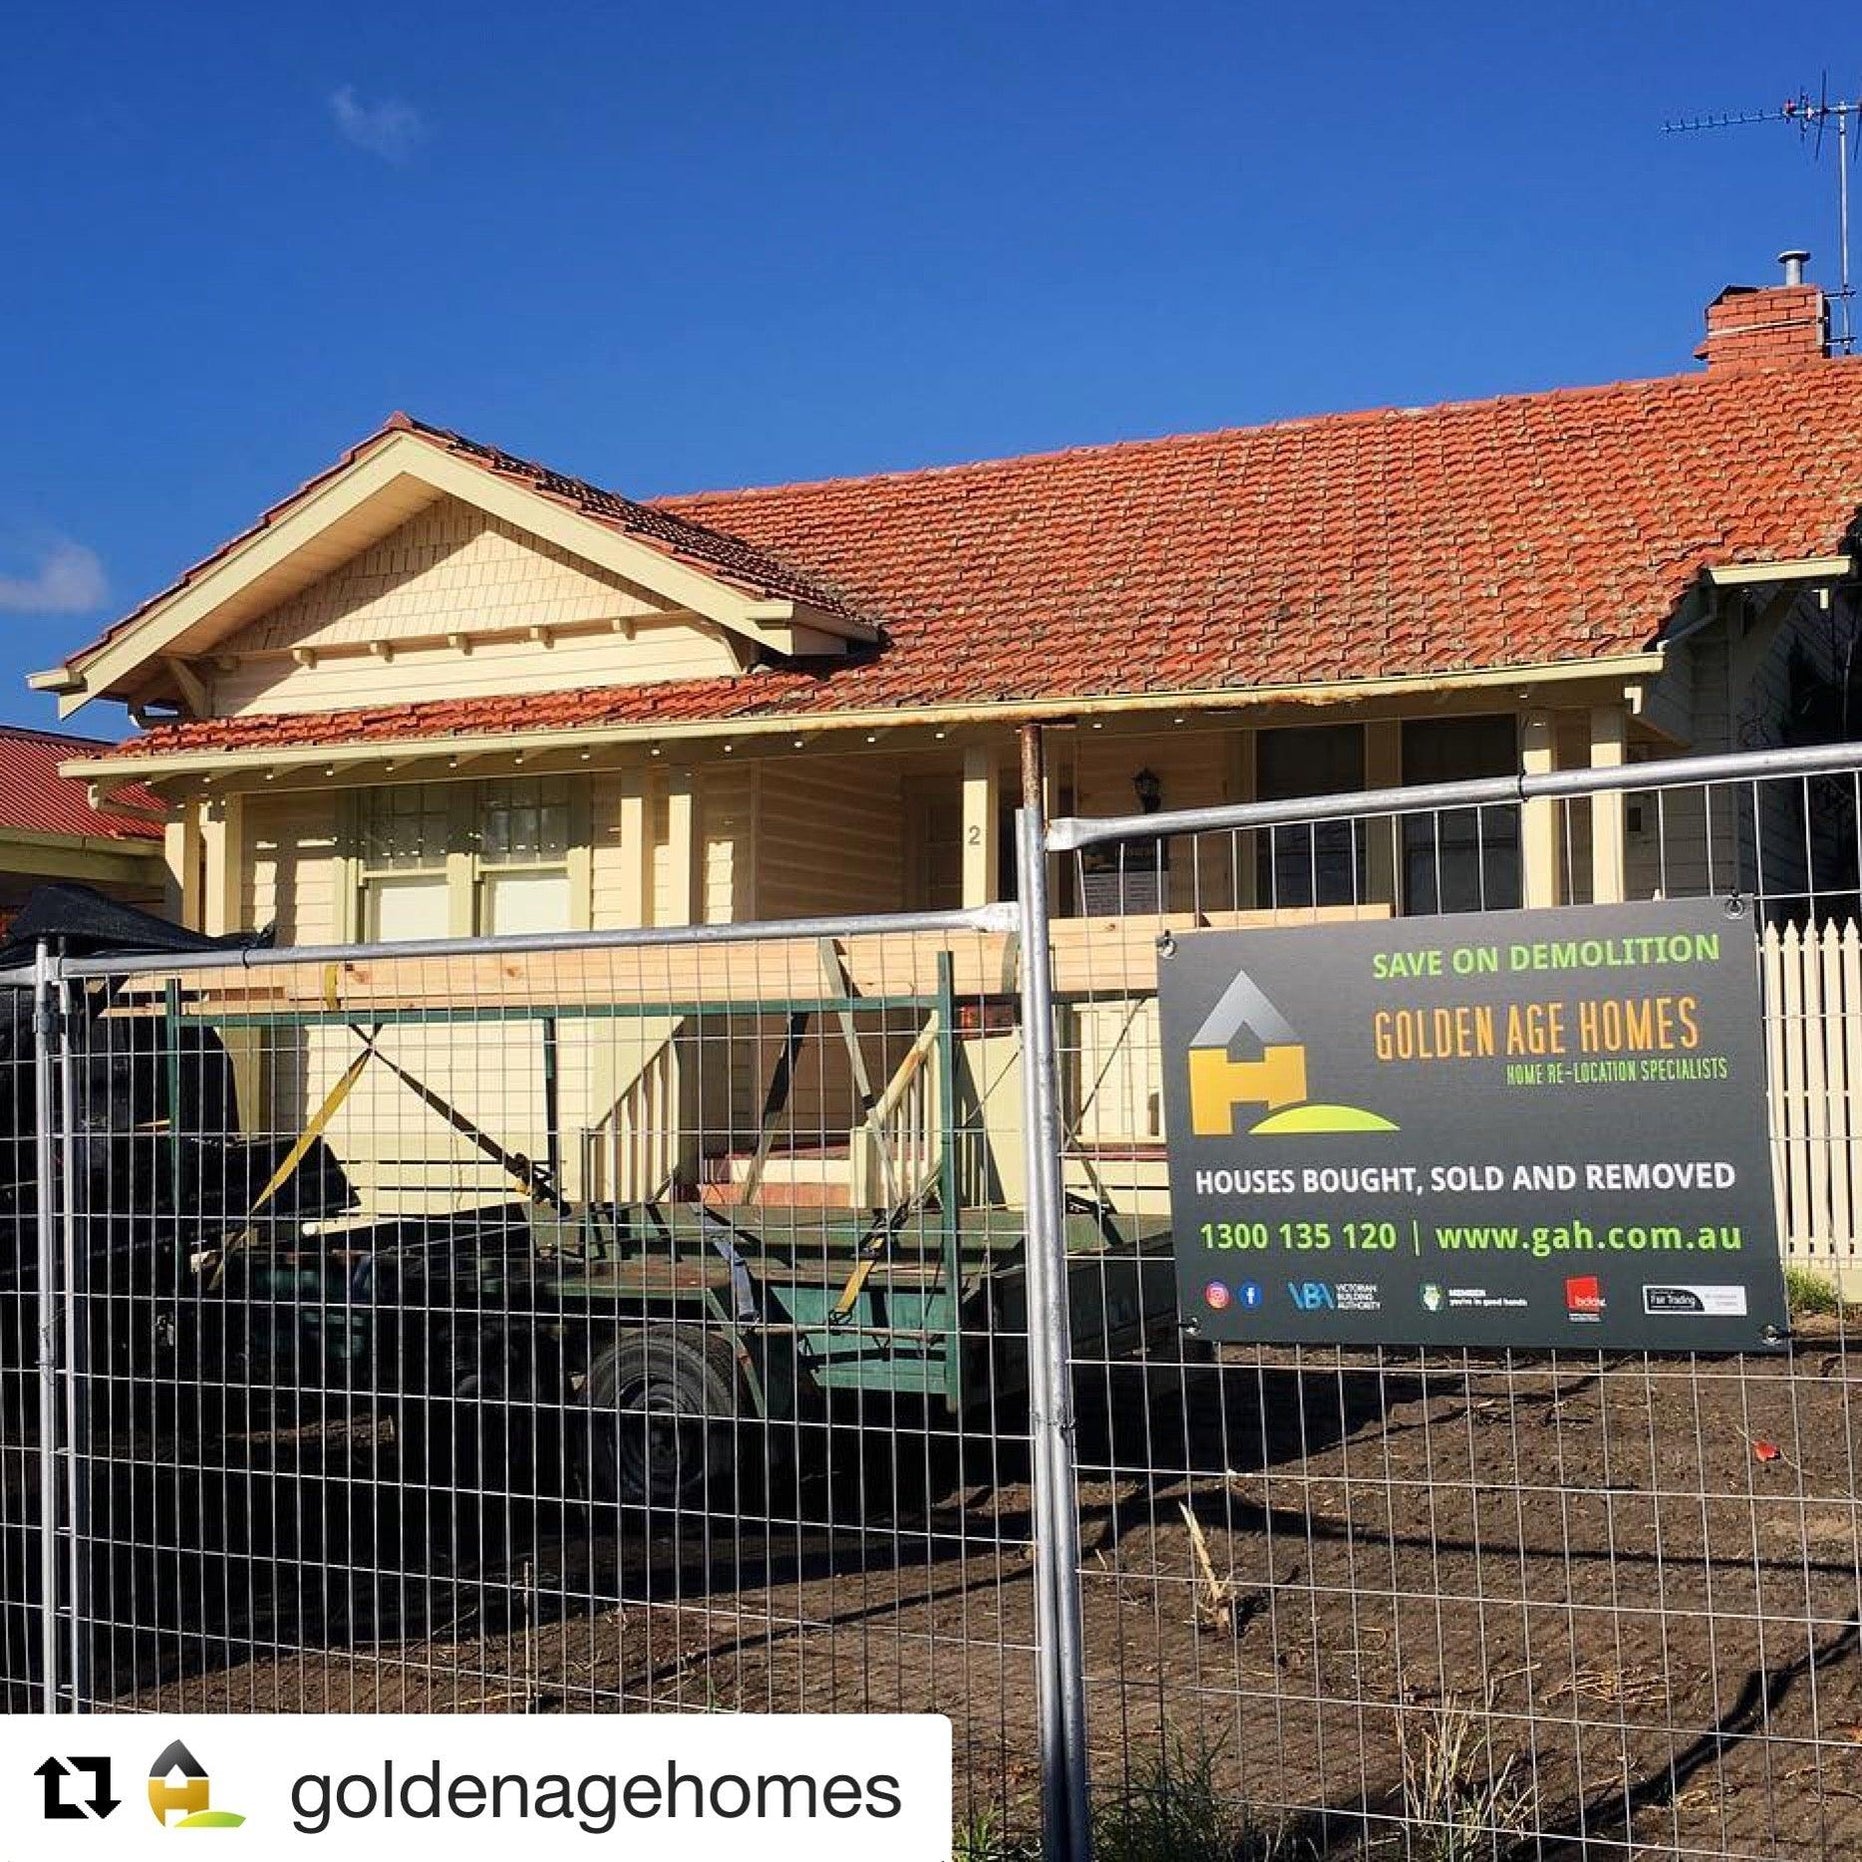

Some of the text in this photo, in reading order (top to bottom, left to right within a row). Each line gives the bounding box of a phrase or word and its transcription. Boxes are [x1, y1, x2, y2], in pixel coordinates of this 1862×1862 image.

[967, 824, 982, 846] 2
[1373, 934, 1720, 978] SAVE ON DEMOLITION
[1374, 996, 1699, 1060] GOLDEN AGE HOMES
[1507, 1057, 1729, 1086] HOME RE-LOCATION SPECIALISTS
[1195, 1162, 1736, 1196] HOUSES BOUGHT, SOLD AND REMOVED
[1200, 1223, 1268, 1249] 1300
[1279, 1223, 1331, 1249] 135
[1342, 1223, 1397, 1249] 120
[1435, 1220, 1742, 1257] www.gah.com.au
